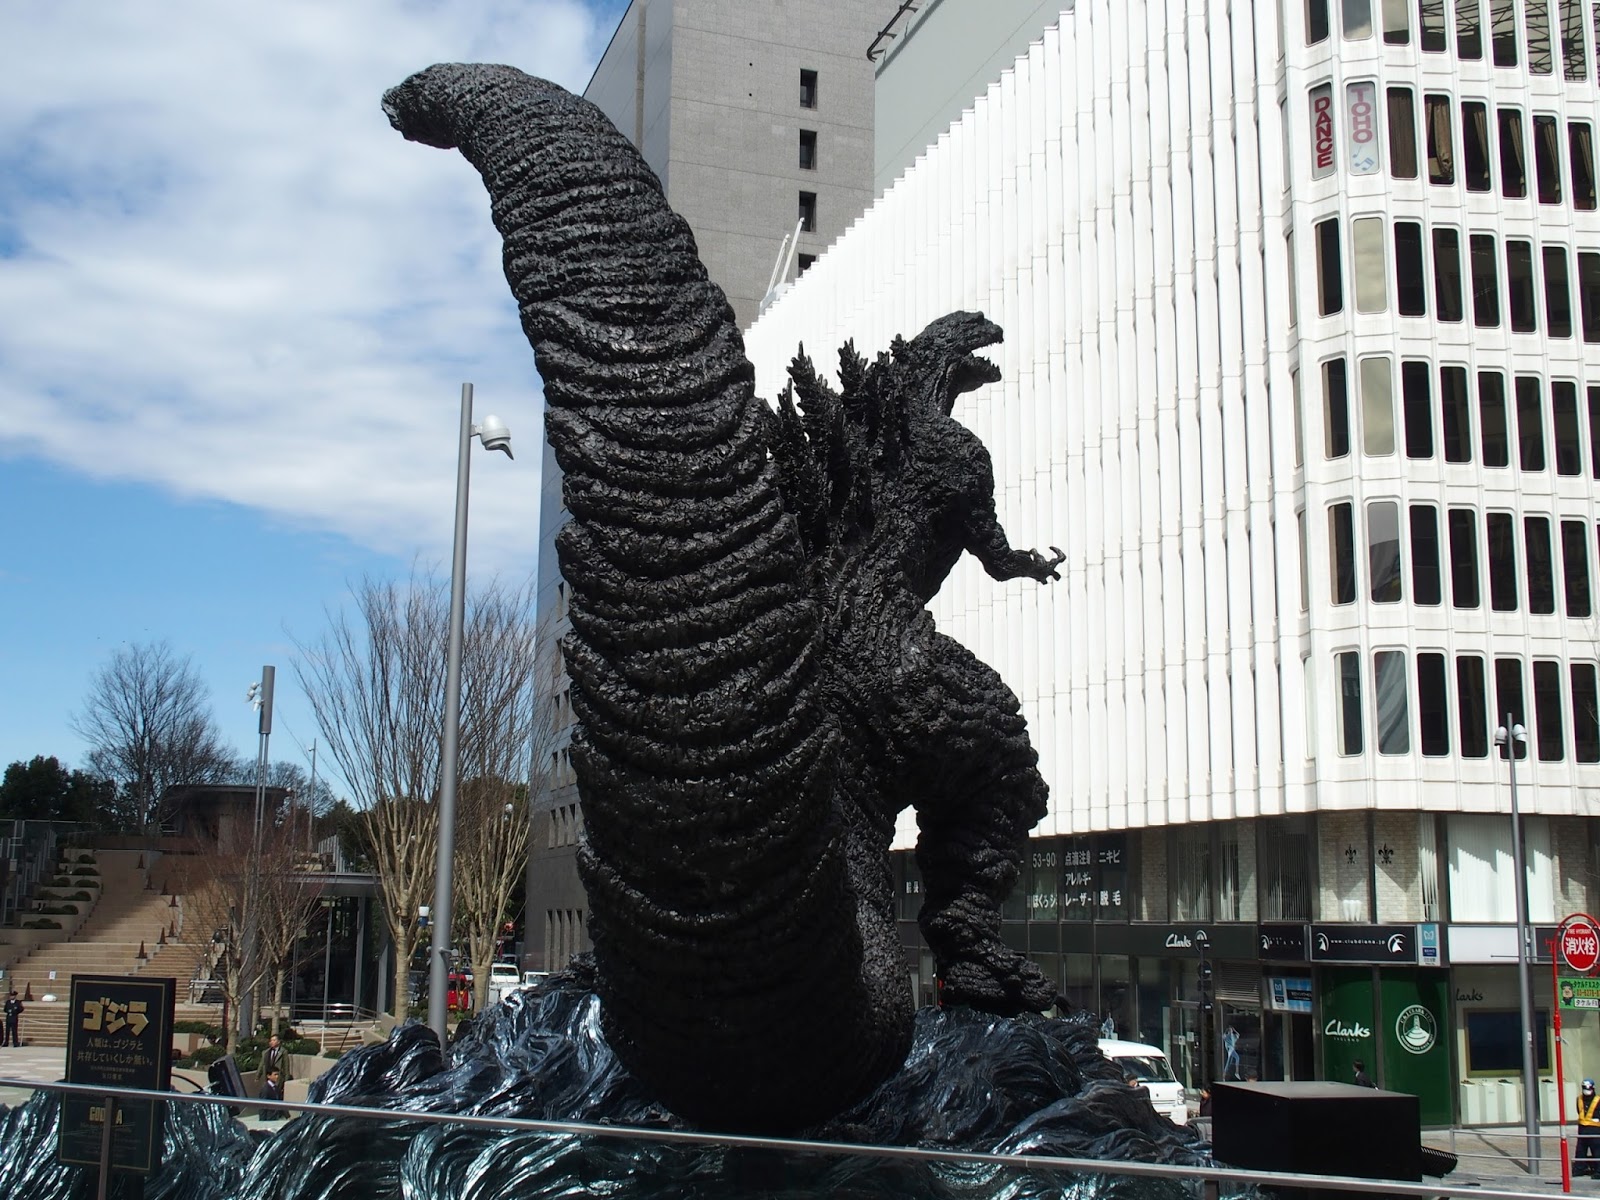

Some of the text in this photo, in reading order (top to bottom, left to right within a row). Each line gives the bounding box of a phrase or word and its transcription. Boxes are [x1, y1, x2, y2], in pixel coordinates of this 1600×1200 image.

[1350, 87, 1373, 144] TOHO
[1314, 96, 1333, 169] DANCE
[1099, 849, 1120, 864] ニキビ
[1165, 933, 1192, 948] Clarks
[1330, 938, 1386, 946] www.clubdiana.jp
[1565, 936, 1596, 956] 消火栓
[1455, 987, 1483, 1001] larks
[83, 997, 149, 1036] ゴジラ
[1325, 1019, 1371, 1038] Clarks
[89, 1106, 123, 1125] GODA
